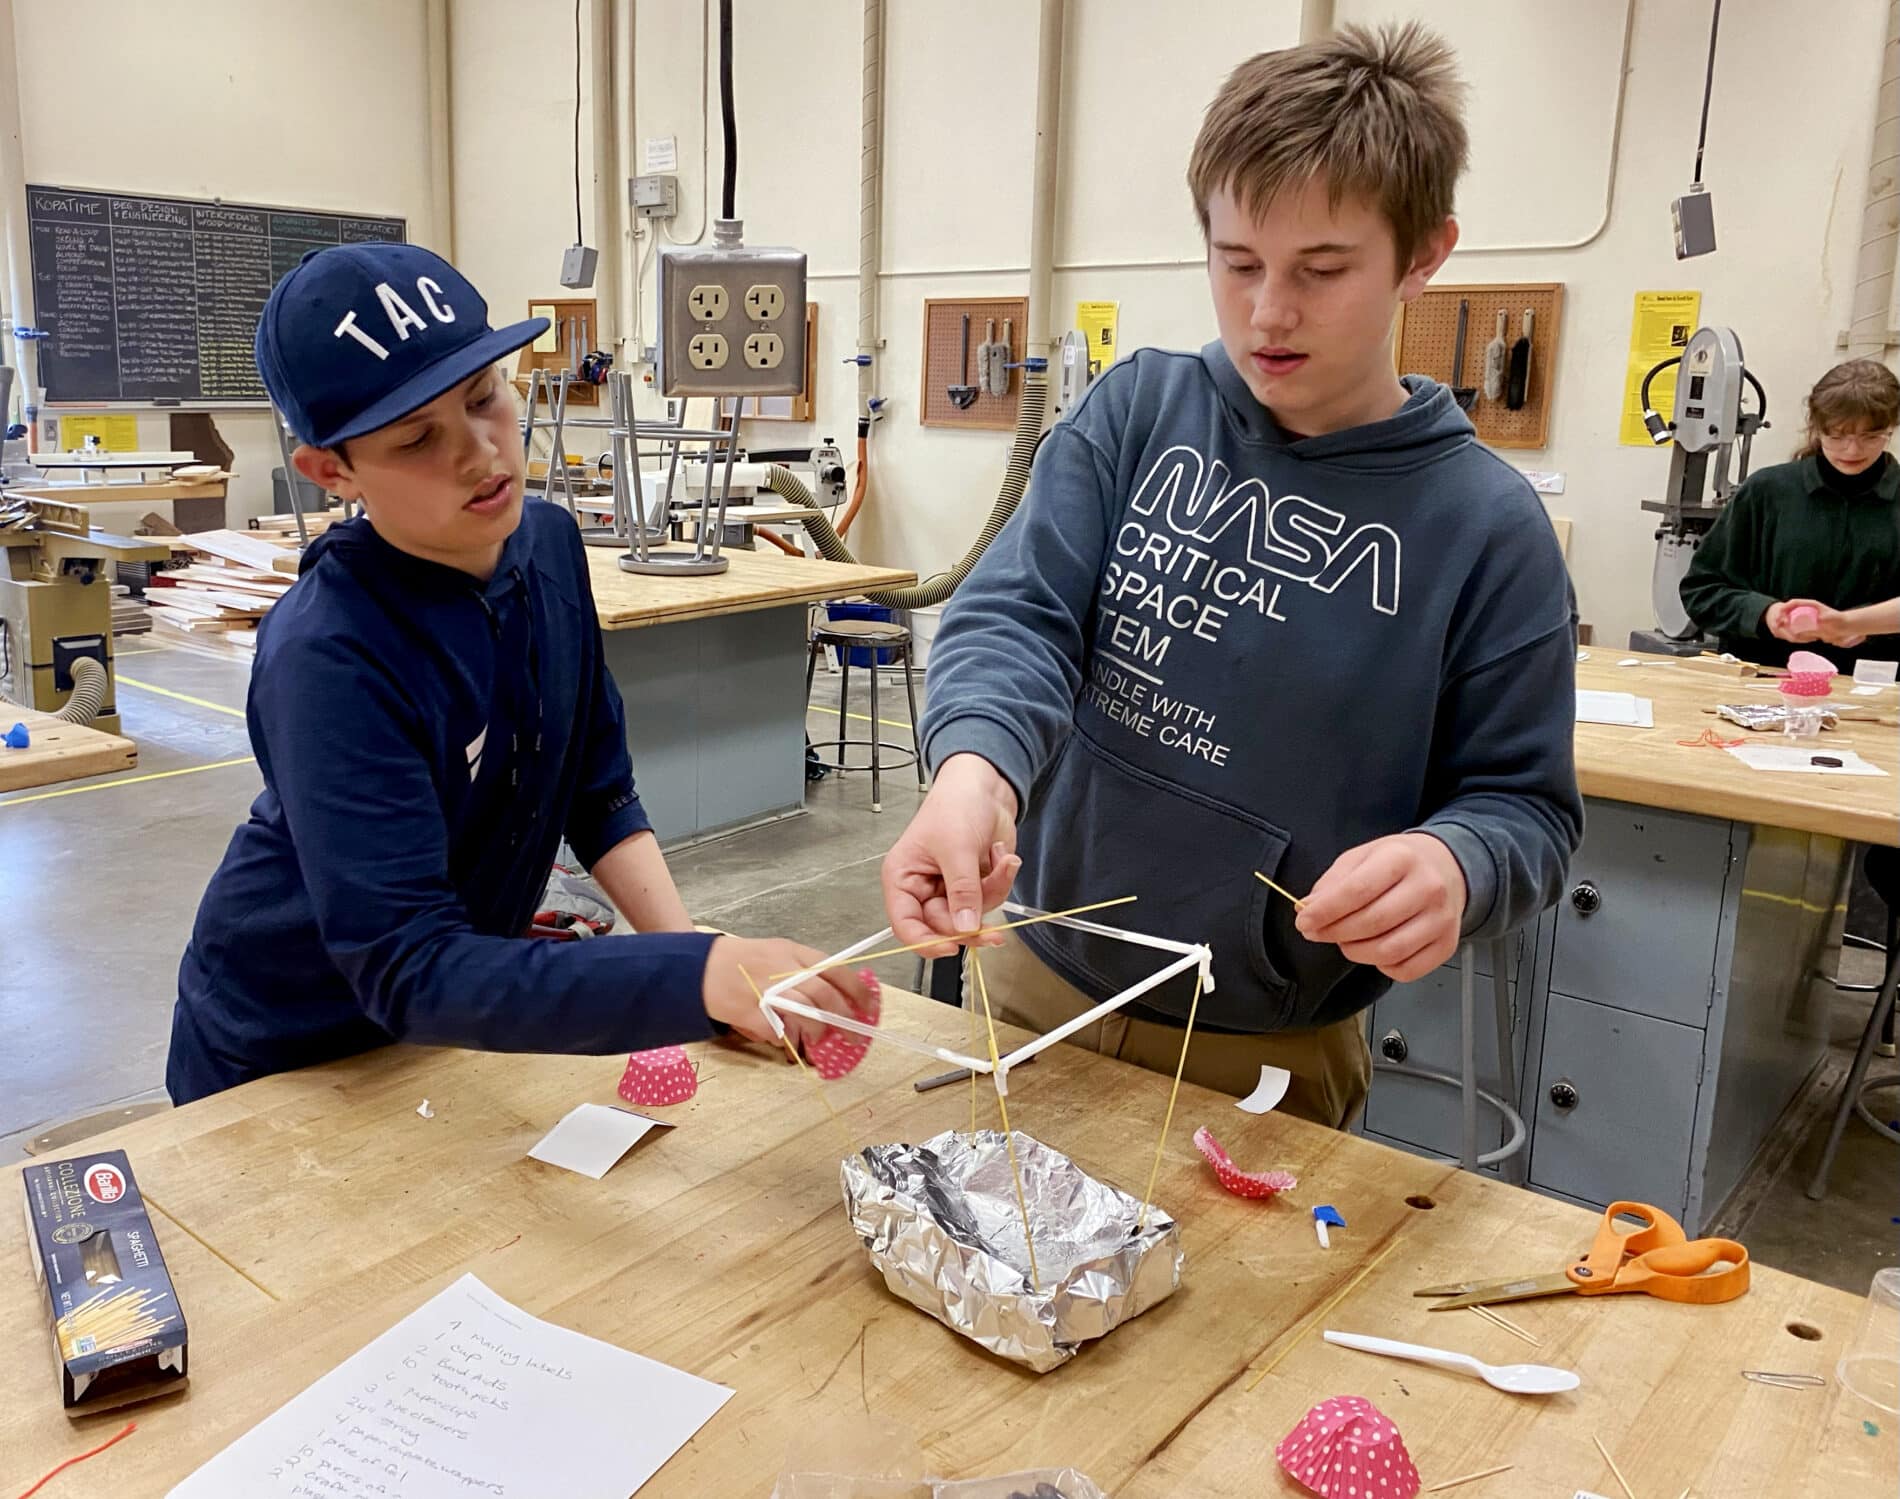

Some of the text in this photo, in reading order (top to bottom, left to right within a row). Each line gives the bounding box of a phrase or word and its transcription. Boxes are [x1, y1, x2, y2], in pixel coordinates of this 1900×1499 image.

[334, 276, 456, 361] TAC
[1130, 445, 1401, 616] NASA
[1101, 560, 1229, 643] SPACE
[1116, 521, 1287, 622] CRITICAL
[1098, 604, 1171, 667] TEM
[1092, 662, 1216, 733] NDLE WITH
[1159, 725, 1231, 767] CARE
[57, 1162, 87, 1220] COLLEZIONE
[95, 1172, 119, 1200] Barilla
[127, 1230, 150, 1268] SPAGHETTI
